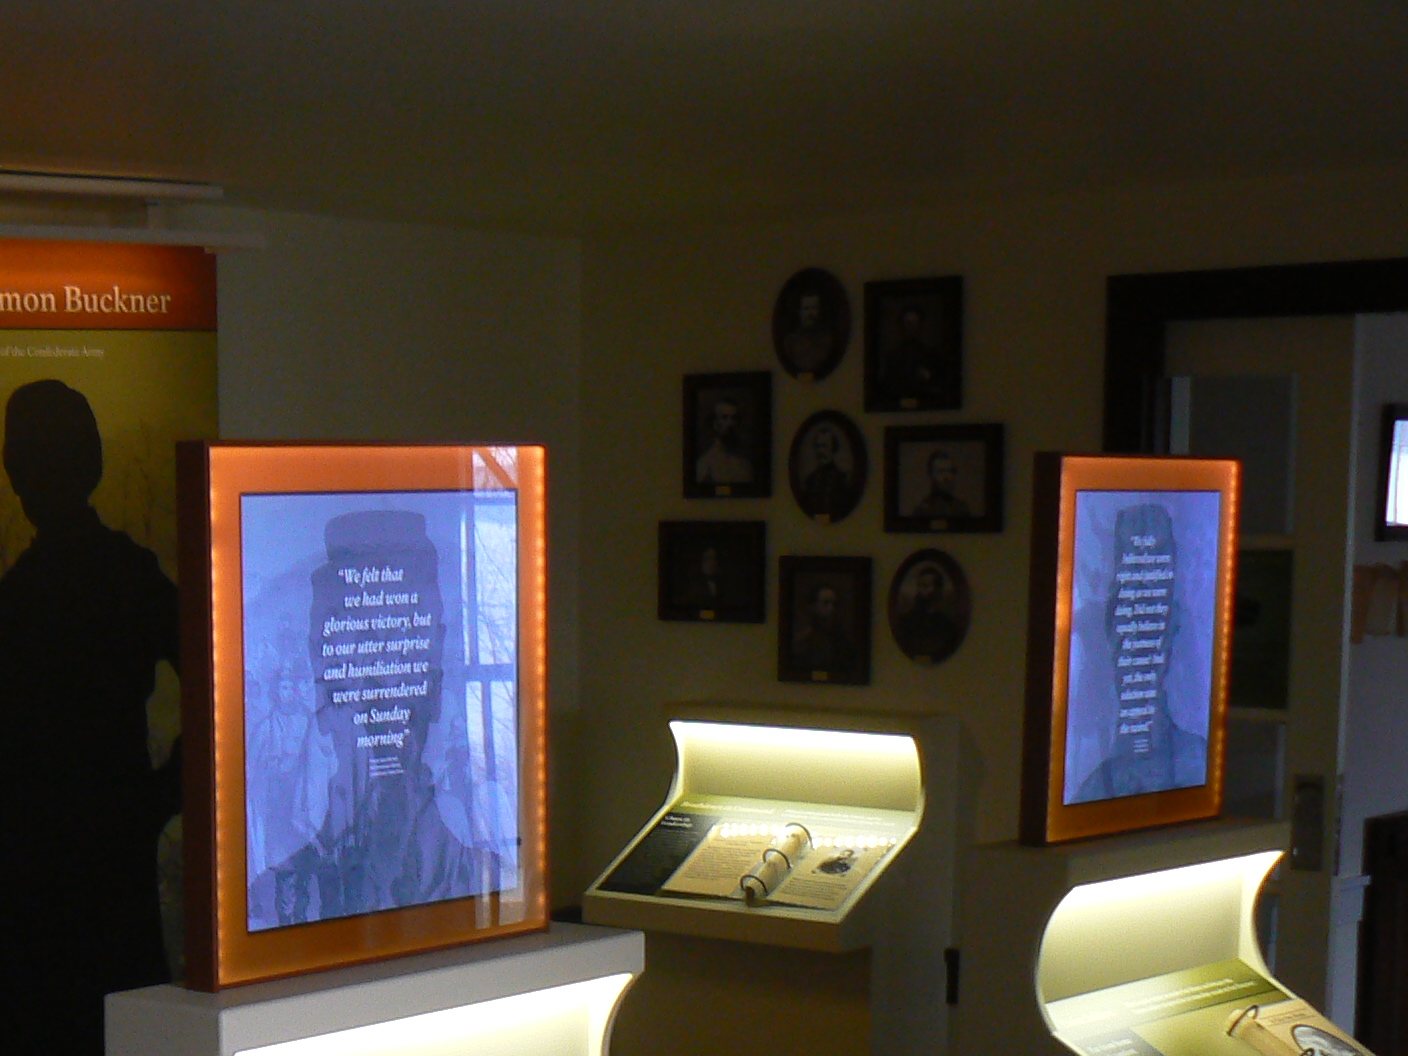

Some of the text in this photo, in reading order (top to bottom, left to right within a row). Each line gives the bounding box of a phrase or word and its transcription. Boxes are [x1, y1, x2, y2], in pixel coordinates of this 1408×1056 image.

[64, 285, 172, 315] Buckner
[361, 566, 379, 588] felt
[381, 565, 404, 582] that
[345, 590, 418, 608] we had won a
[323, 612, 431, 636] glorious victory, but
[322, 638, 430, 657] to our utter surprise
[323, 661, 429, 681] and humiliation we
[333, 681, 427, 703] were surrendered
[353, 707, 411, 725] on Sunday
